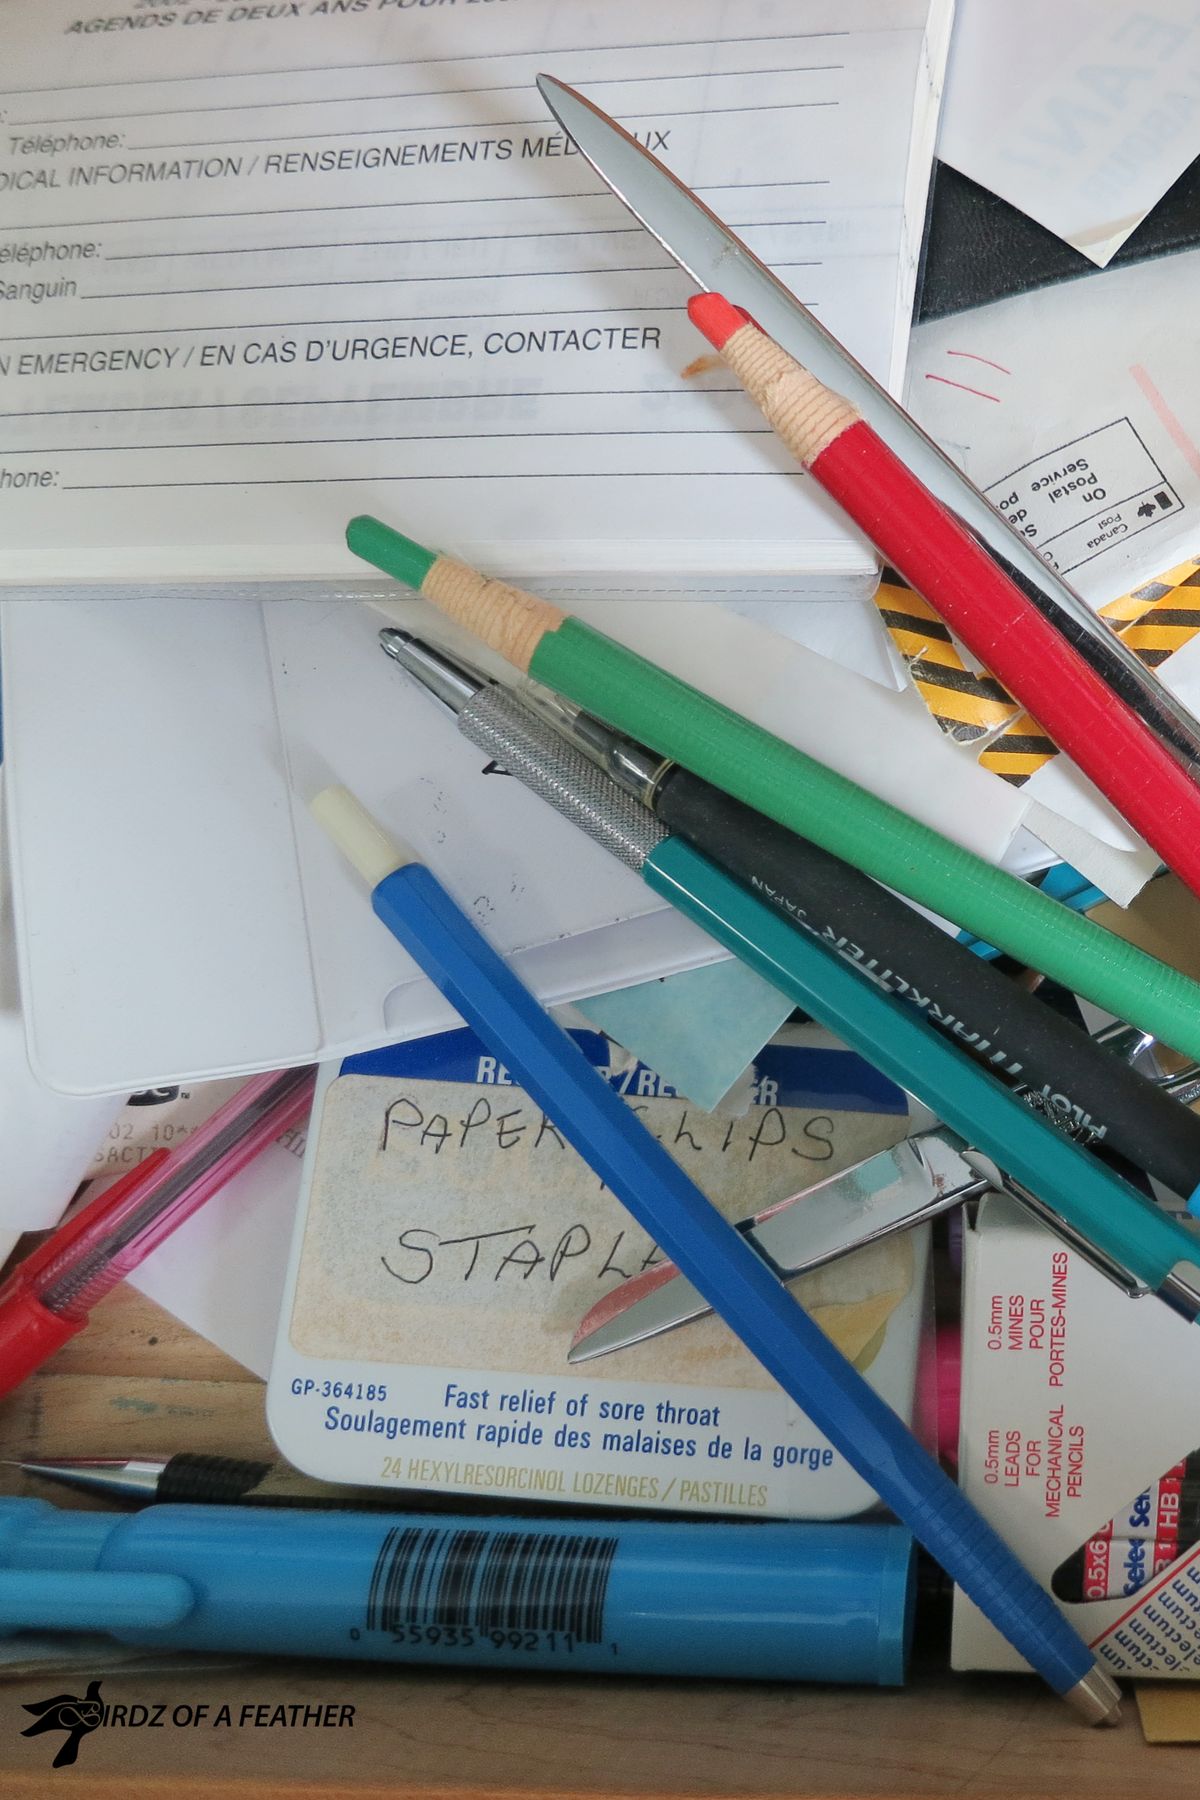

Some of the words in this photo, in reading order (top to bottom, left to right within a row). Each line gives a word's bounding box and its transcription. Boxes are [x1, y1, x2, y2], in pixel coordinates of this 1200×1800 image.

[184, 9, 219, 26] DE
[227, 2, 302, 22] DEUX
[10, 133, 126, 156] Téléphone:
[69, 157, 244, 186] INFORMATION
[264, 138, 513, 174] RENSEIGNEMENTS
[0, 241, 103, 266] éléphone:
[17, 347, 180, 375] EMERGENCY
[200, 345, 236, 366] EN
[243, 341, 297, 364] CAS
[306, 334, 473, 362] D'URGENCE,
[484, 327, 662, 355] CONTACTER
[1031, 458, 1090, 492] Service
[1048, 472, 1099, 504] Postal
[1082, 487, 1107, 503] On
[1086, 523, 1129, 550] Canada
[752, 875, 807, 917] JAPAN
[1040, 1084, 1107, 1139] PILOT
[988, 1295, 1003, 1350] 0.5mm
[1009, 1295, 1024, 1351] MINES
[1030, 1299, 1045, 1349] POUR
[1049, 1252, 1068, 1387] PORTES-MINES
[291, 1378, 388, 1402] GP-364185
[444, 1384, 490, 1411] Fast
[499, 1389, 557, 1416] relief
[566, 1394, 590, 1416] of
[599, 1401, 645, 1421] sore
[656, 1400, 720, 1427] throat
[324, 1405, 467, 1440] Soulagement
[476, 1419, 544, 1448] rapide
[553, 1424, 592, 1449] des
[602, 1429, 697, 1457] malaises
[708, 1435, 733, 1459] de
[743, 1437, 763, 1461] la
[772, 1445, 834, 1470] gorge
[985, 1430, 1000, 1485] 0.5mm
[1005, 1430, 1021, 1487] LEADS
[1026, 1440, 1041, 1477] FOR
[1046, 1404, 1064, 1518] MECHANICAL
[380, 1456, 403, 1479] 24
[407, 1458, 567, 1493] HEXYLRESORCINOL
[573, 1472, 660, 1500] LOZENGES
[679, 1480, 768, 1507] PASTILLES
[1067, 1426, 1084, 1498] PENCILS
[351, 1627, 361, 1641] 0
[392, 1624, 475, 1648] 55935
[490, 1630, 575, 1653] 99211
